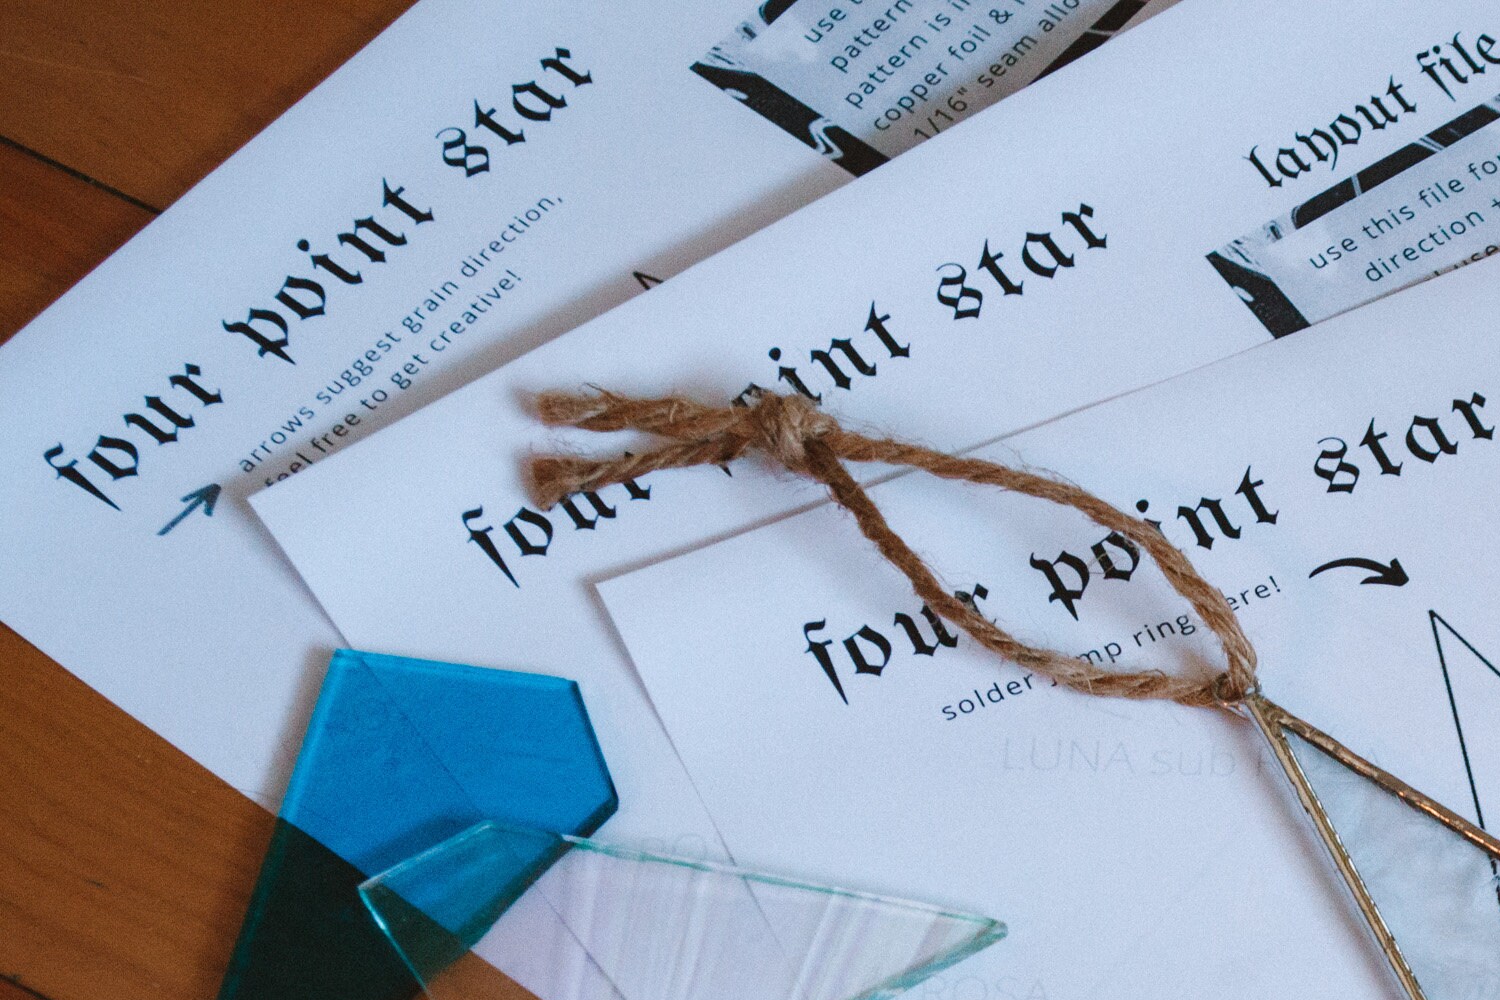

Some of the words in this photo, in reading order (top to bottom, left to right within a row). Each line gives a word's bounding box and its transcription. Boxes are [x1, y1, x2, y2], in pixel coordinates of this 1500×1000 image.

[804, 8, 847, 44] use
[830, 0, 914, 74] pattern
[845, 35, 928, 109] pattern
[928, 12, 952, 32] is
[874, 62, 949, 131] copper
[948, 24, 992, 62] foil
[988, 8, 1014, 25] &
[976, 35, 1039, 88] seam
[1242, 75, 1418, 188] layout
[936, 202, 1108, 320] star
[1308, 237, 1358, 269] use
[1361, 204, 1415, 240] this
[1417, 178, 1465, 208] file
[1364, 210, 1484, 282] direction
[42, 362, 225, 512] four
[221, 177, 436, 367] point
[435, 46, 595, 178] star
[239, 404, 316, 474] arrows
[315, 331, 402, 405] suggest
[401, 280, 460, 335] grain
[460, 196, 564, 278] direction,
[311, 413, 362, 464] free
[360, 387, 390, 415] to
[390, 354, 432, 392] get
[430, 269, 522, 352] creative!
[1313, 391, 1496, 494] star
[939, 674, 1036, 723] solder
[1133, 613, 1197, 650] ring
[1002, 736, 1135, 774] LUNA
[1150, 742, 1237, 778] sub
